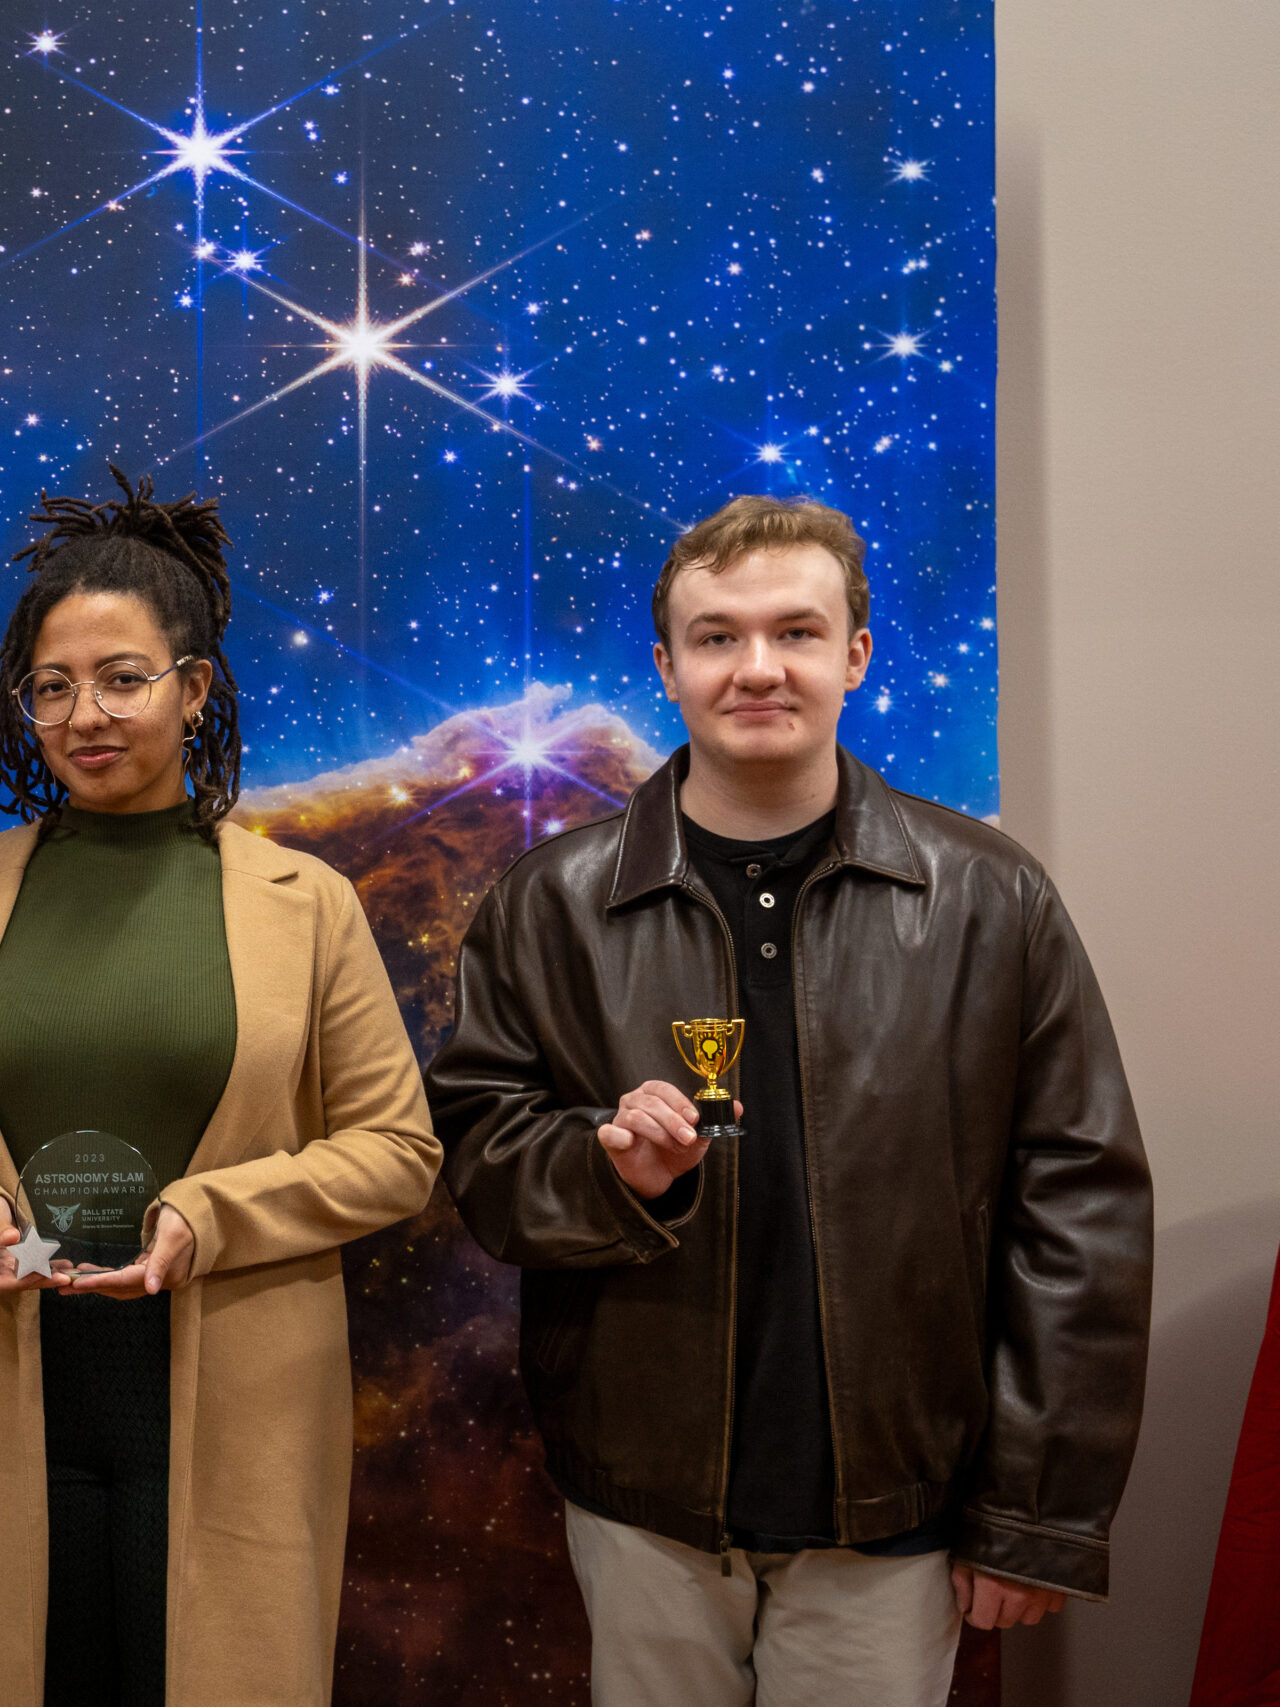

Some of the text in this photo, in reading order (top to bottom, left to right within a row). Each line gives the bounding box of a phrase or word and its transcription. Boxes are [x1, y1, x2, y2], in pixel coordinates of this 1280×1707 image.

[75, 1154, 105, 1163] 2023
[35, 1172, 144, 1184] ASTRONOMY SLAM
[34, 1186, 145, 1195] CHAMPION AWARD
